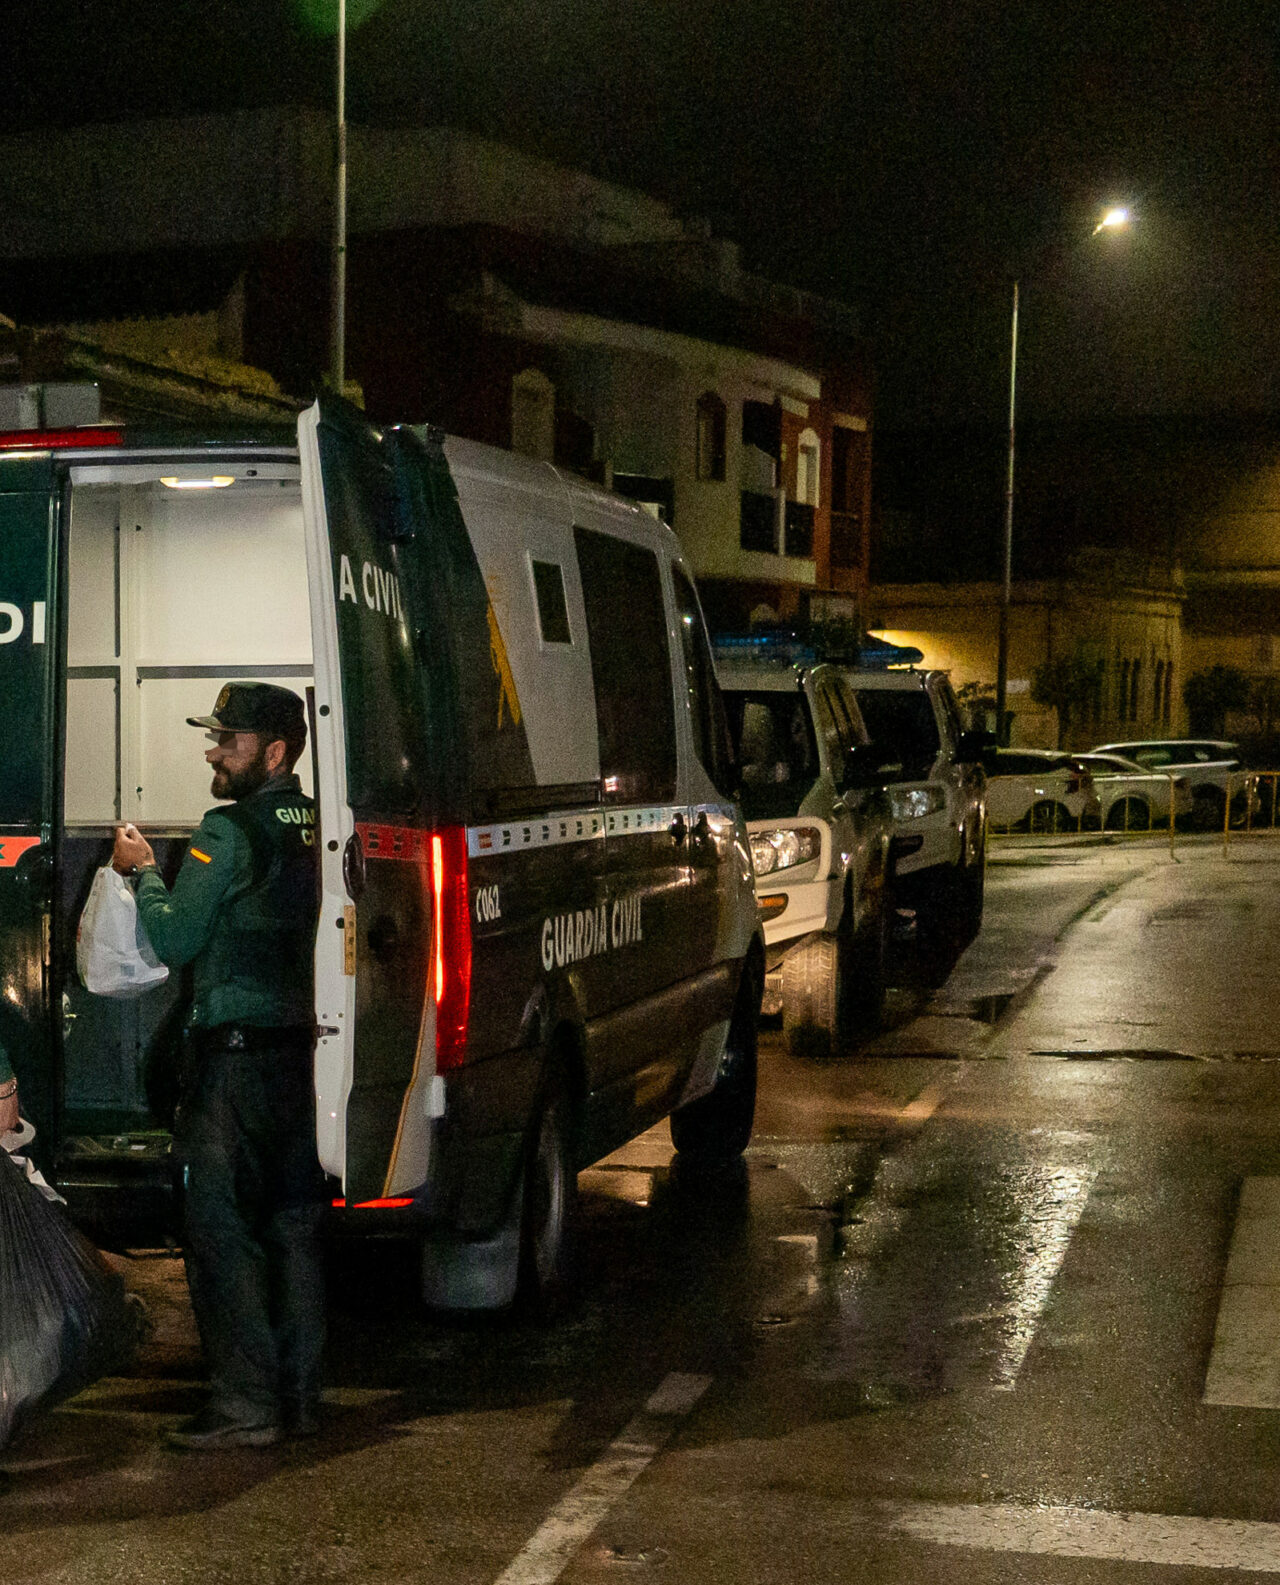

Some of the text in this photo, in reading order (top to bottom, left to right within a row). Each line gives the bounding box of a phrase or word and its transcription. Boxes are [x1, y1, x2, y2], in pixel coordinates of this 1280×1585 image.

[339, 554, 404, 621] A CIVIL
[275, 807, 315, 825] GUA
[541, 895, 642, 971] GUARDIA CIVIL
